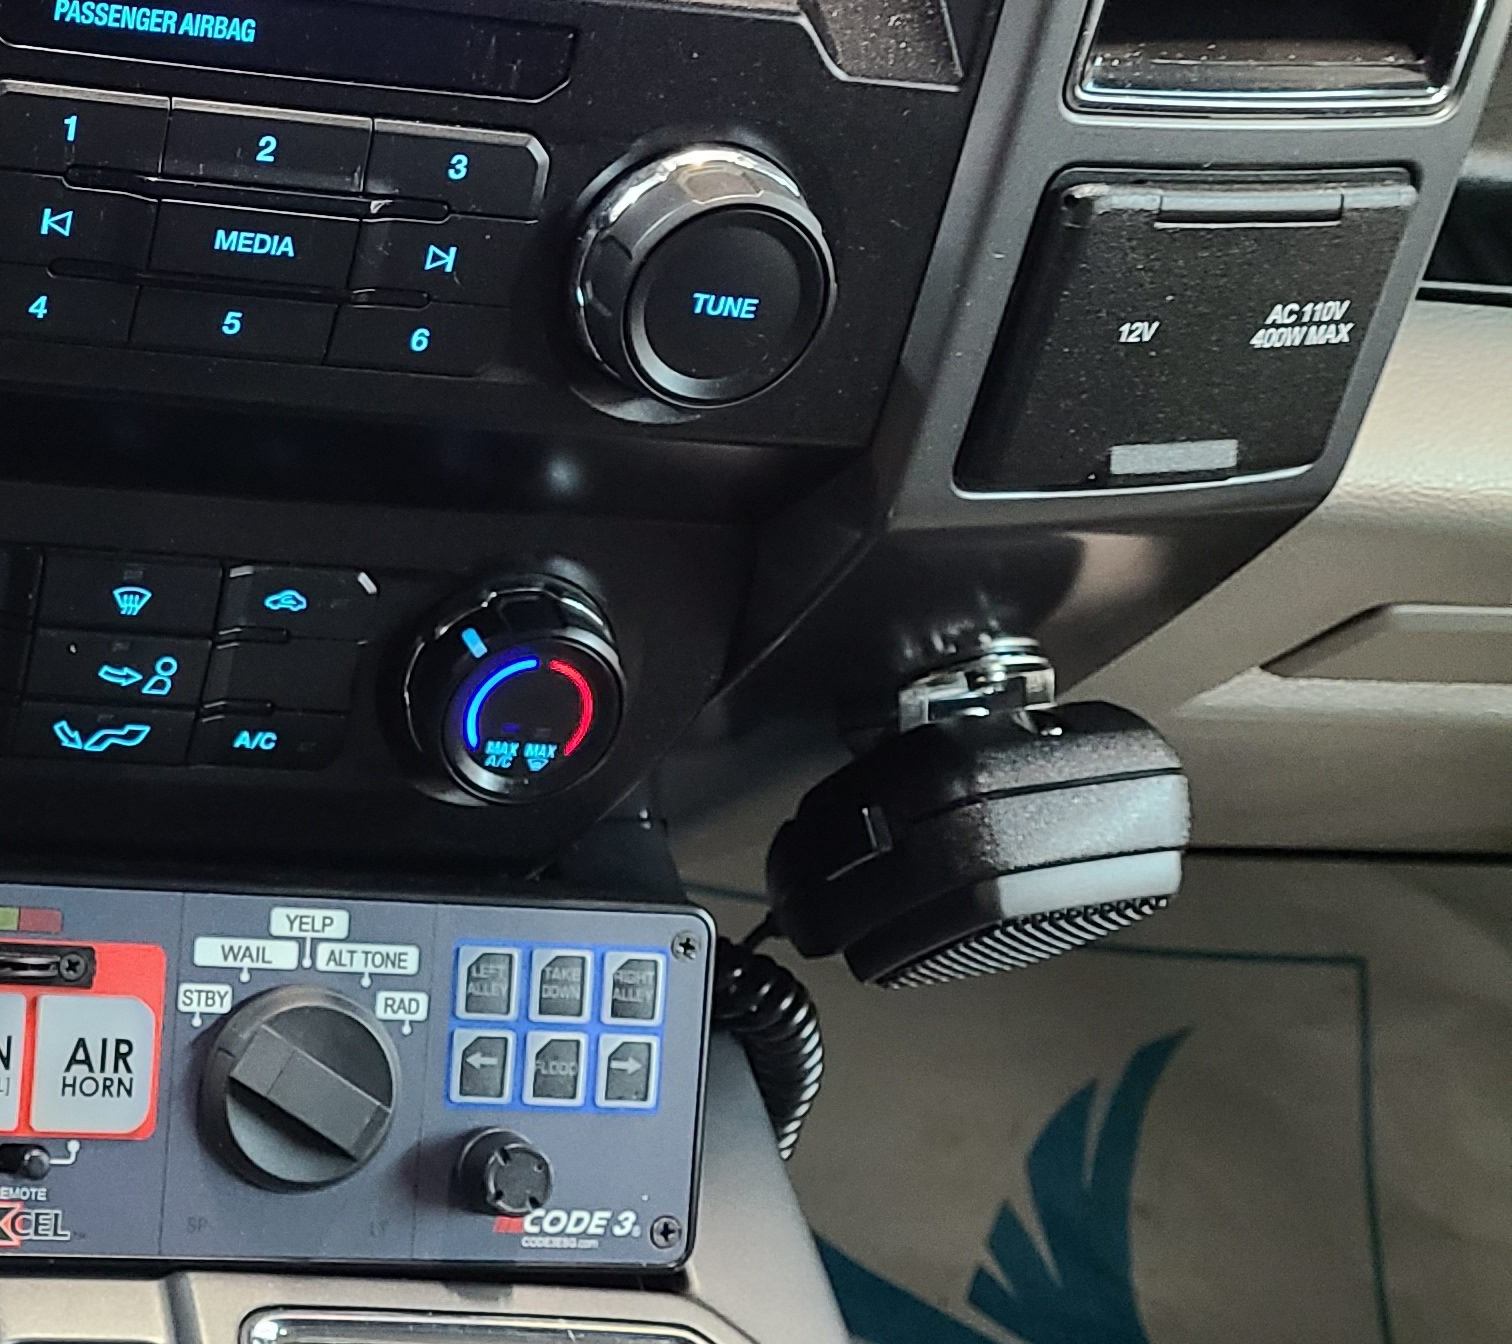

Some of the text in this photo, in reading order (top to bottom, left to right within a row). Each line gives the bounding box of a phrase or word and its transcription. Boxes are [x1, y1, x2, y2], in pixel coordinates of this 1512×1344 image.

[178, 11, 257, 44] AIRBAG
[62, 115, 78, 142] 1
[255, 136, 278, 162] 2
[447, 155, 469, 180] 3
[213, 229, 295, 257] MEDIA
[28, 295, 49, 319] 4
[692, 291, 760, 321] TUNE
[1264, 299, 1351, 325] AC 110V
[221, 311, 244, 335] 5
[1118, 321, 1160, 344] 12V
[409, 328, 430, 352] 6
[1249, 322, 1355, 349] 400W MAX
[233, 730, 278, 751] A/C
[484, 740, 520, 757] MAX
[523, 742, 558, 759] MAX
[484, 755, 514, 769] A/C
[285, 913, 334, 934] YELP
[220, 944, 273, 965] WAIL
[326, 949, 409, 970] ALT TONE
[470, 964, 505, 978] LEFT
[544, 966, 581, 980] TAKE
[613, 970, 655, 985] RIGHT
[182, 988, 229, 1008] STBY
[468, 982, 509, 997] ALLEY
[542, 985, 581, 1000] DOWN
[613, 987, 654, 1002] ALLEY
[383, 997, 420, 1016] RAD
[64, 1037, 134, 1074] AIR
[61, 1076, 134, 1098] HORN
[523, 1208, 611, 1235] CODE
